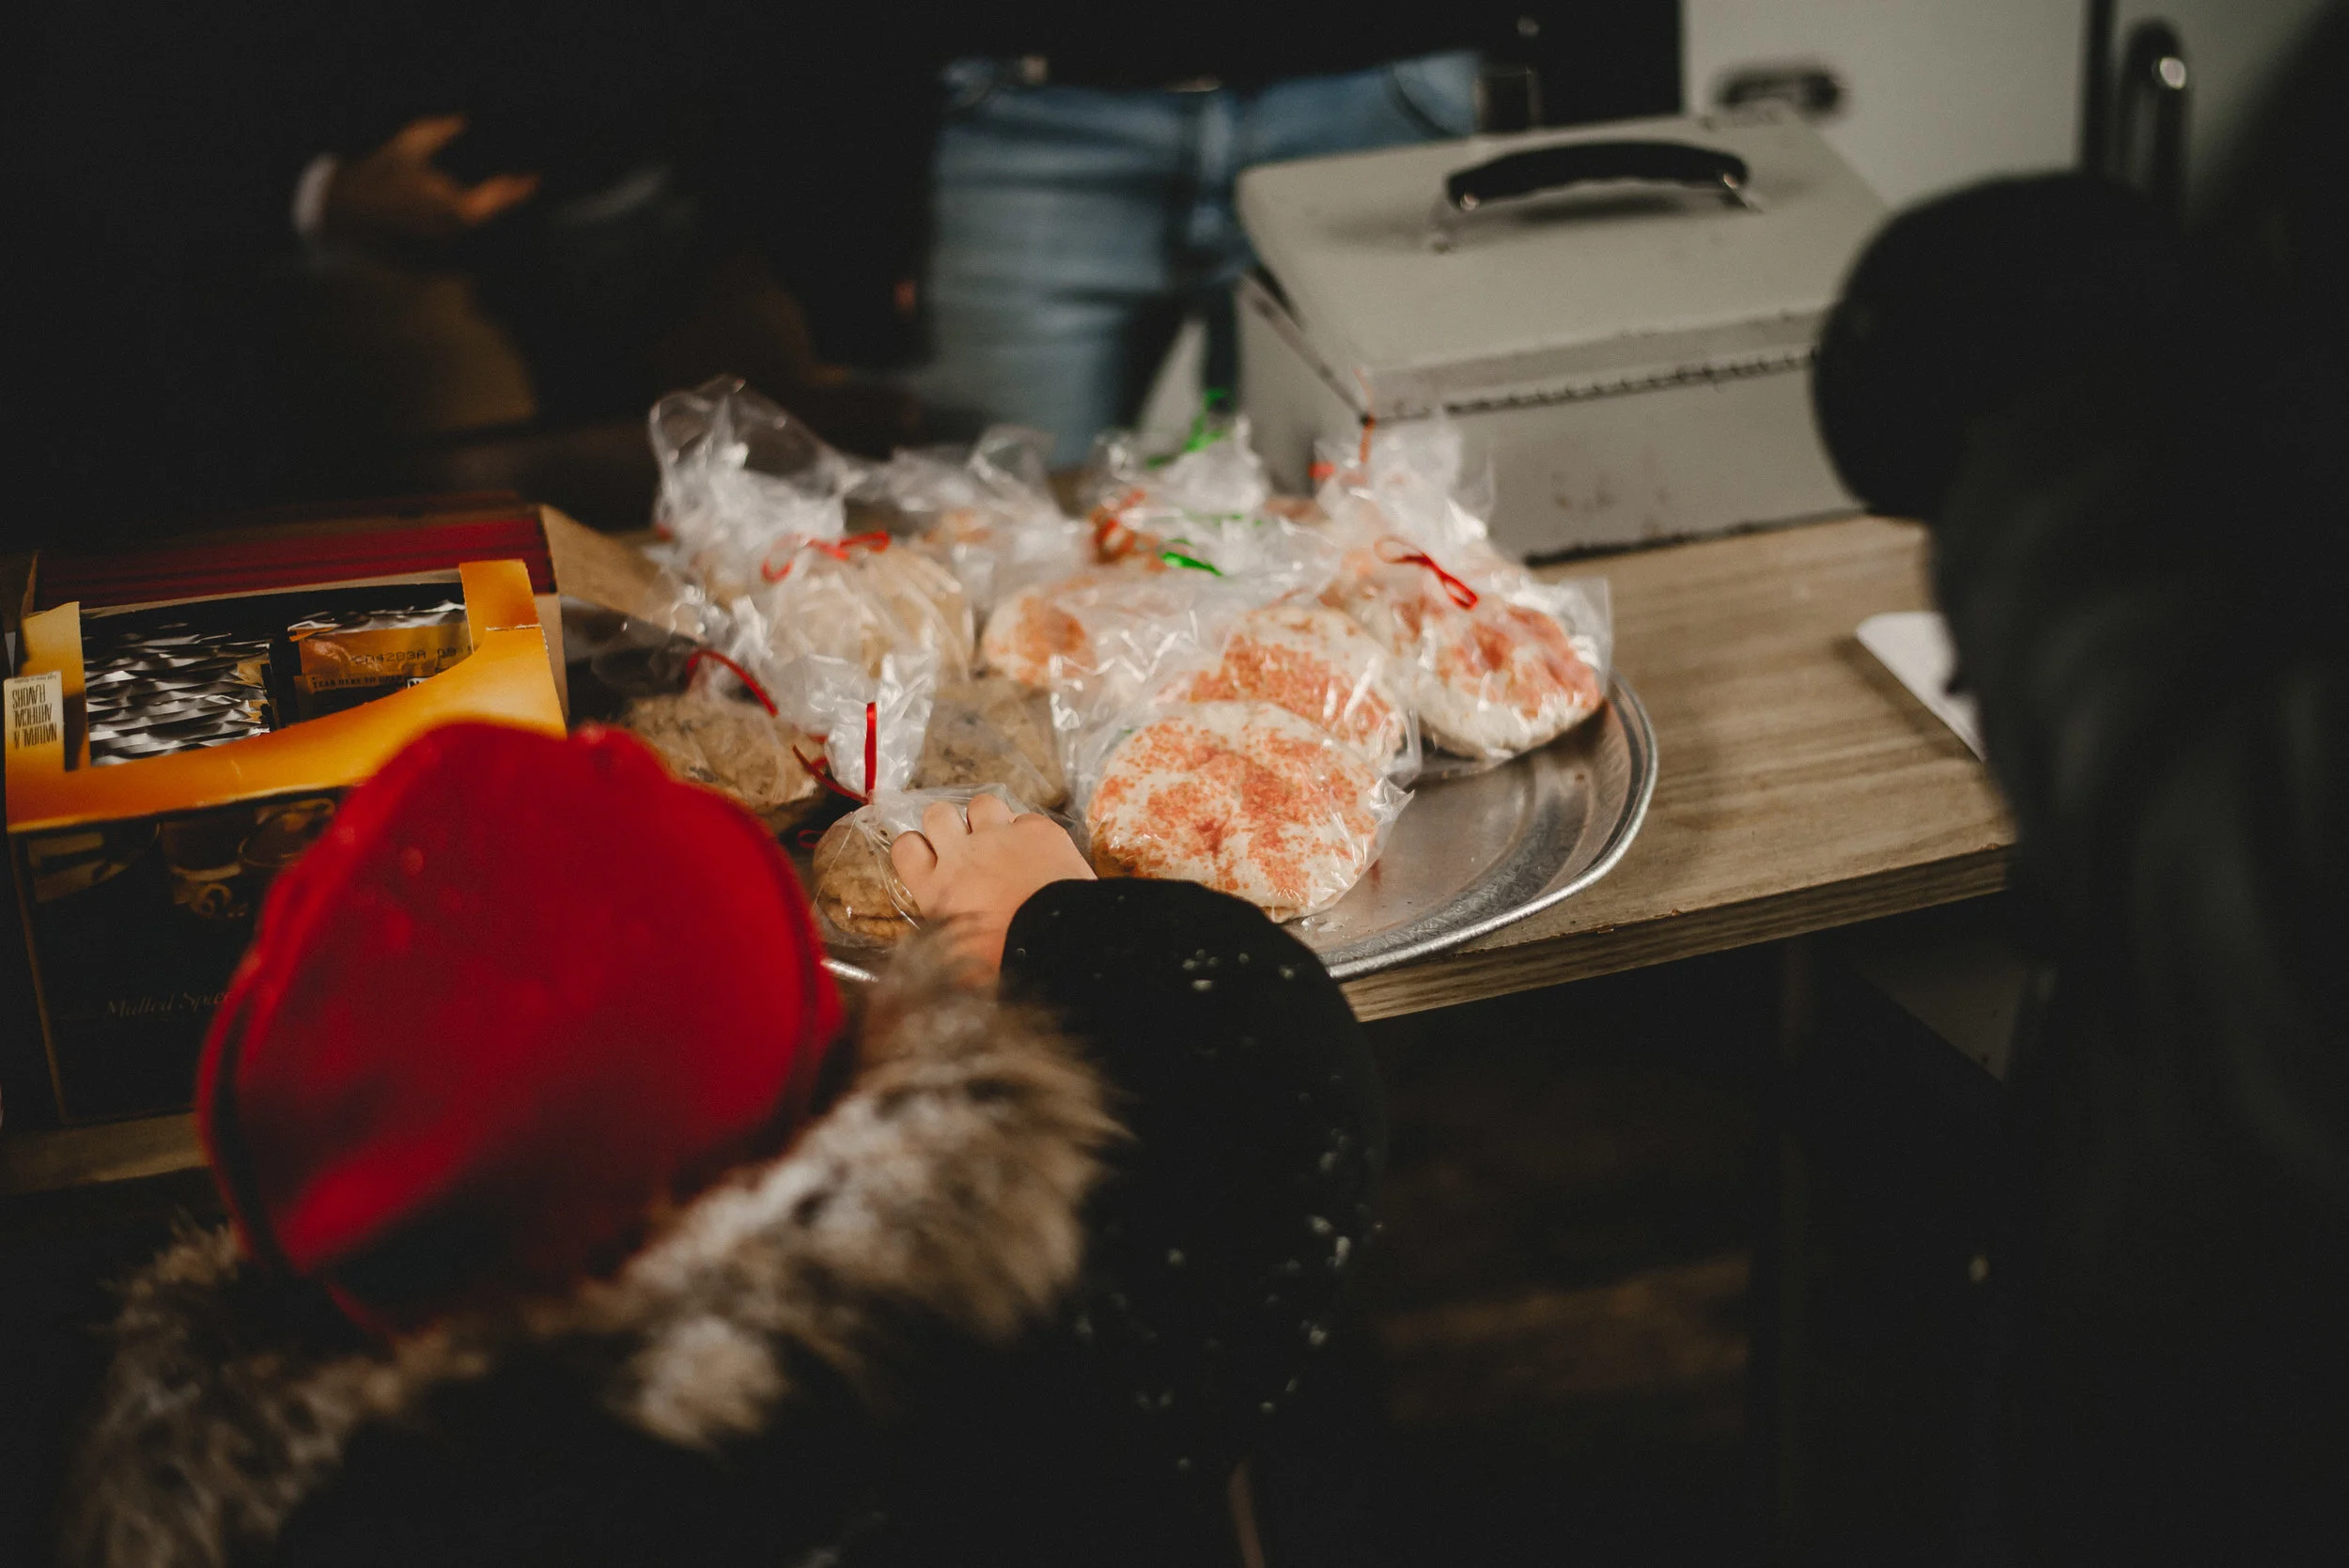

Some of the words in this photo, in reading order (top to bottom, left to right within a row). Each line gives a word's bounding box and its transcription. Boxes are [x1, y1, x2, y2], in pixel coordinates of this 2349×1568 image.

[12, 684, 46, 709] FLAVORS
[14, 703, 52, 729] ARTIFICIAL
[23, 722, 57, 747] NATURAL
[105, 991, 176, 1018] Mulled
